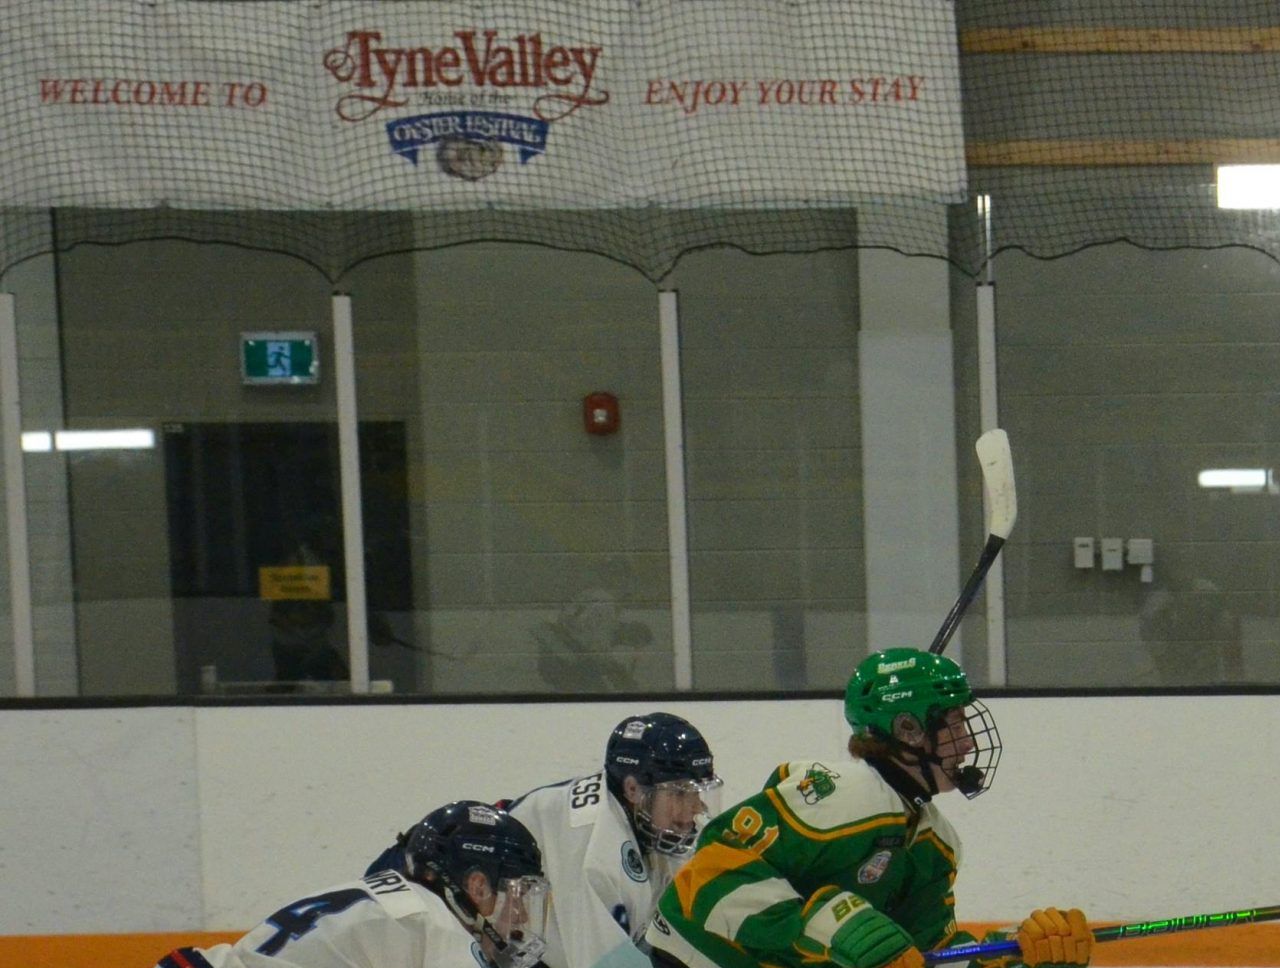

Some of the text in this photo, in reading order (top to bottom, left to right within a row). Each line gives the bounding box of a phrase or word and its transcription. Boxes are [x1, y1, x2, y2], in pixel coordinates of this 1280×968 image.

[39, 78, 267, 107] WELCOME TO
[644, 75, 924, 114] ENJOY YOUR STAY
[881, 690, 913, 702] CCM
[616, 756, 639, 766] CCM
[462, 842, 495, 854] CCM
